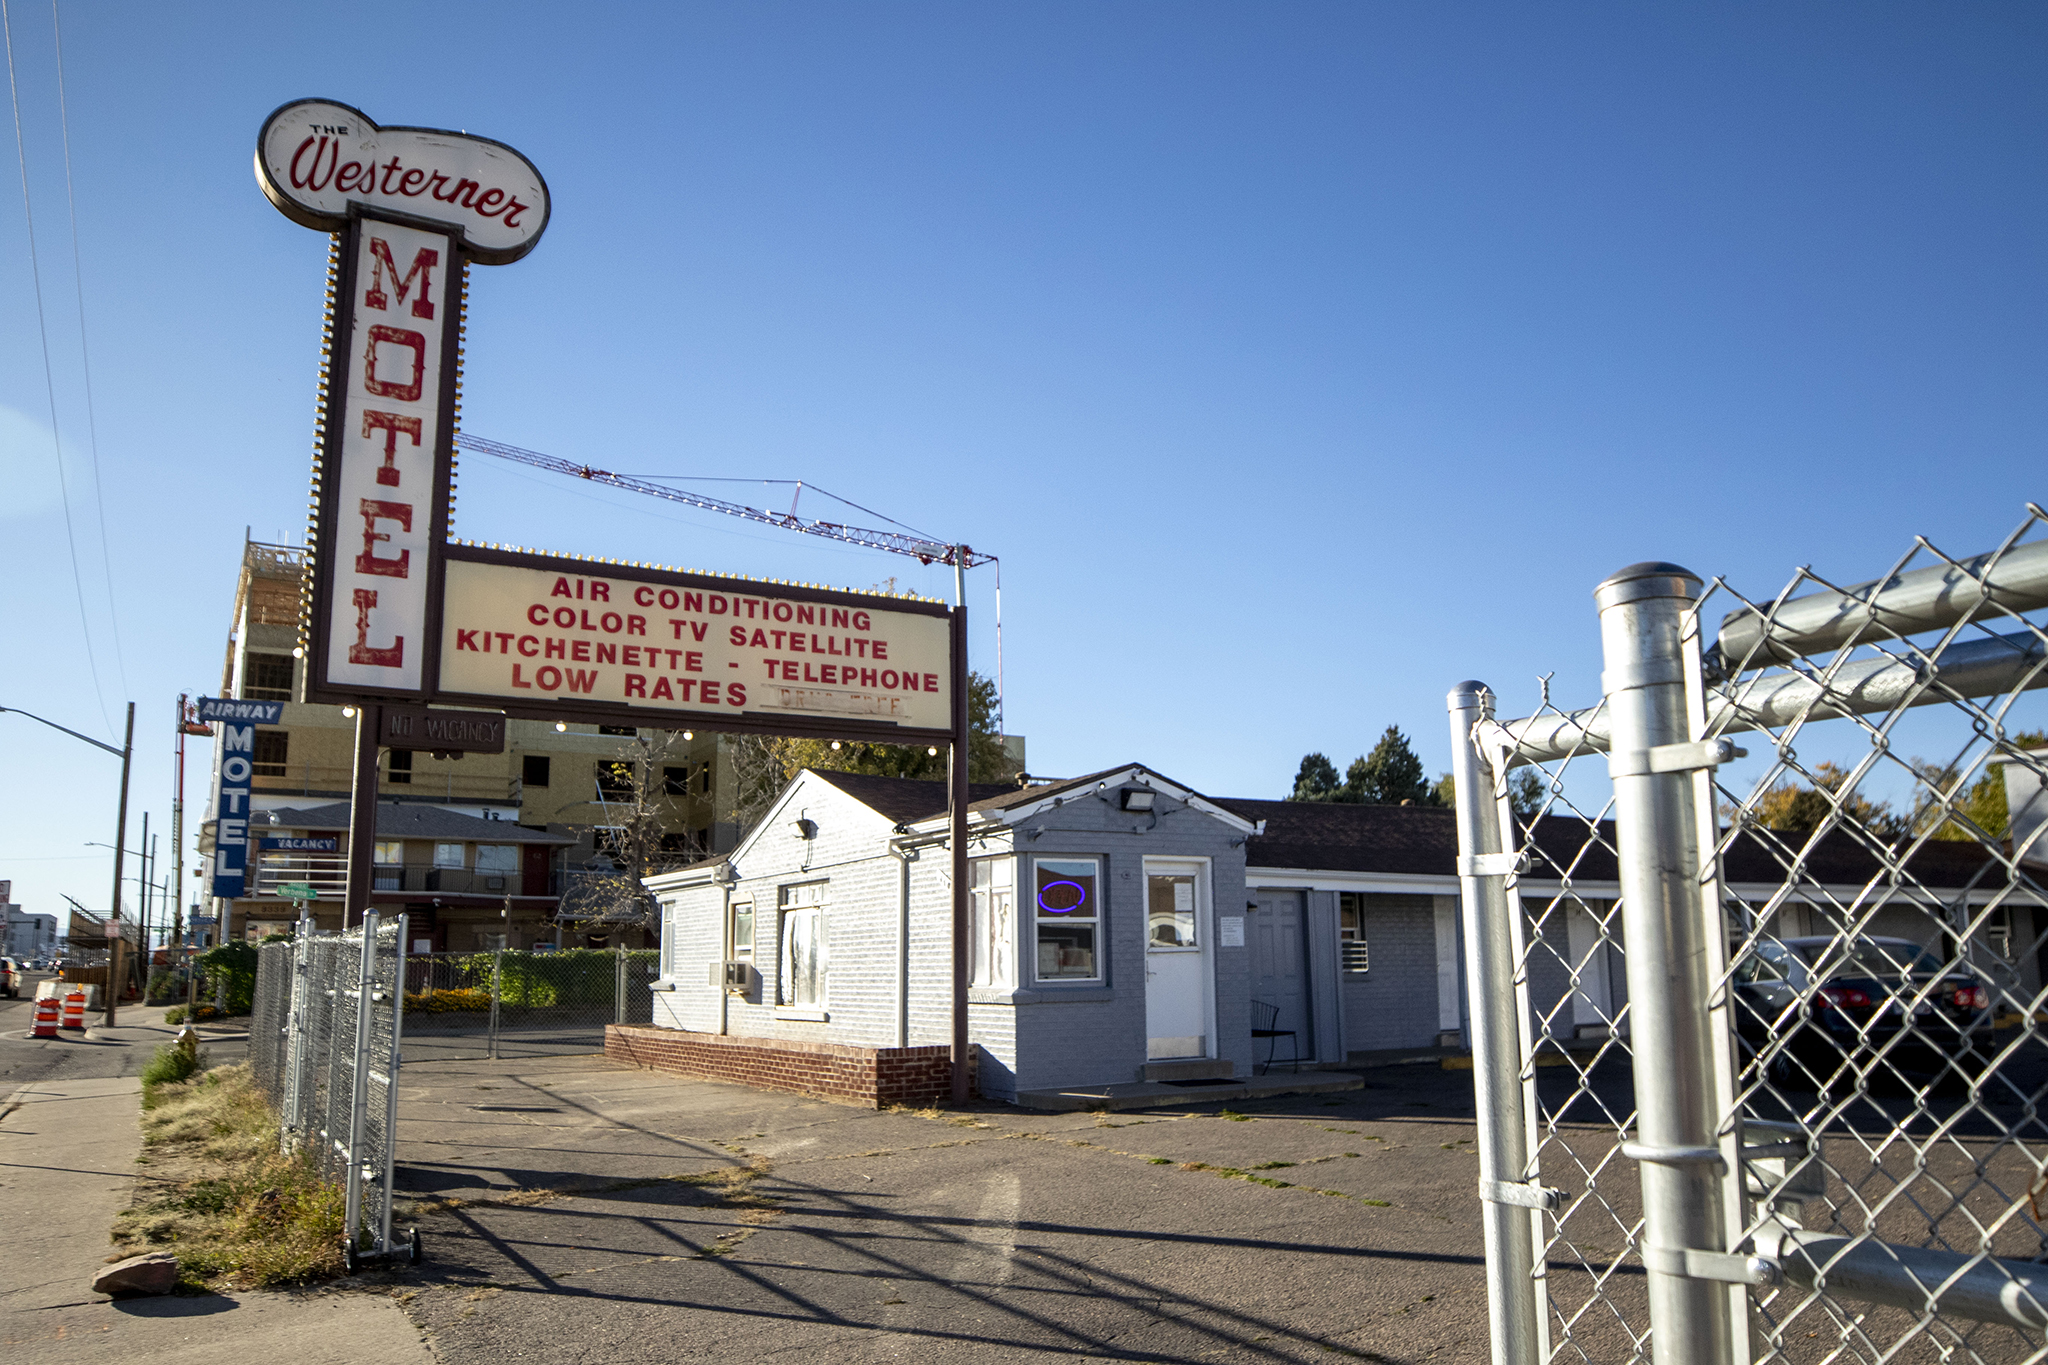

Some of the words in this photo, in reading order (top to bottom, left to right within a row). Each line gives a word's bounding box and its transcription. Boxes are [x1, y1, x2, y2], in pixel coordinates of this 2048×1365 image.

[309, 123, 349, 136] THE
[289, 135, 530, 228] Westerner
[348, 236, 439, 669] MOTEL
[550, 577, 610, 603] AIR
[633, 586, 871, 631] CONDITIONING
[526, 603, 647, 637] COLOR
[668, 618, 709, 642] TV
[729, 625, 888, 660] SATELLITE
[456, 628, 703, 673] KITCHENETTE
[762, 658, 939, 693] TELEPHONE
[512, 663, 598, 694] LOW
[624, 673, 747, 707] RATES
[202, 702, 277, 720] AIRWAY
[427, 719, 499, 742] VACANCY
[215, 725, 254, 877] MOTEL
[278, 838, 334, 850] VACANCY
